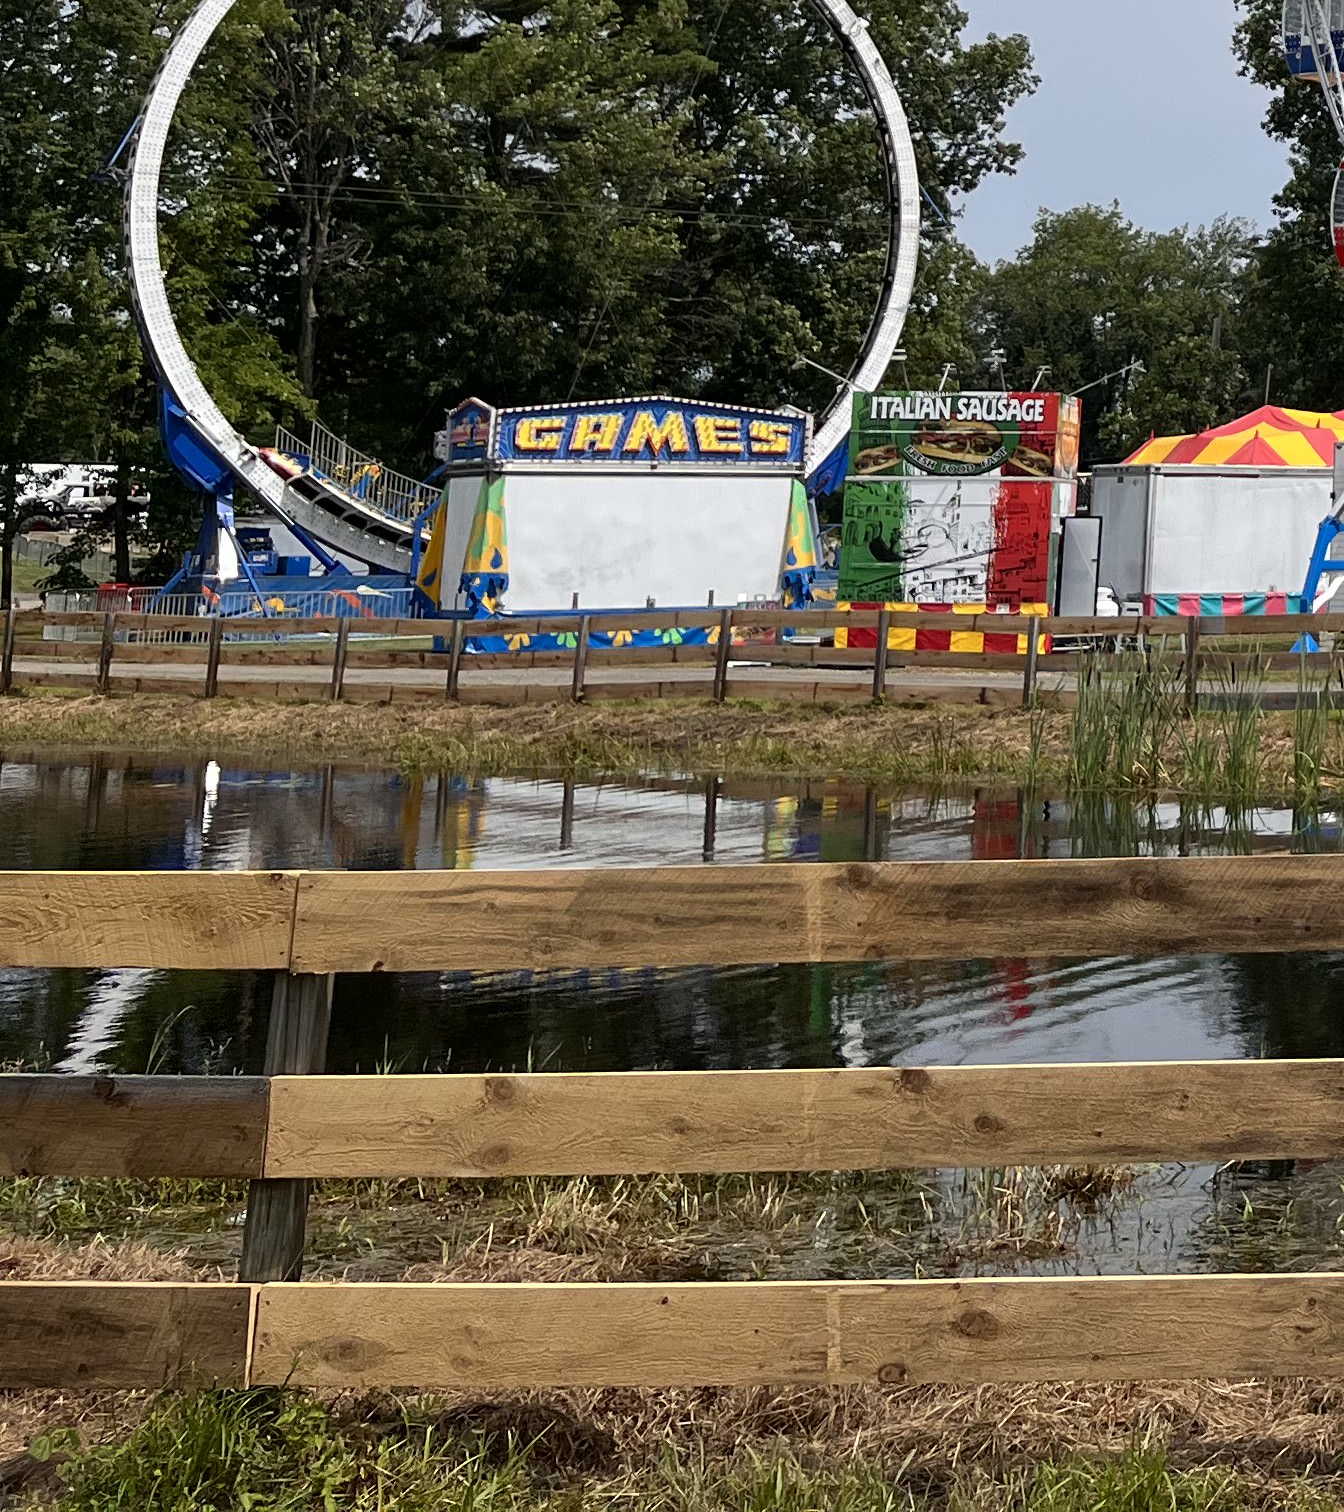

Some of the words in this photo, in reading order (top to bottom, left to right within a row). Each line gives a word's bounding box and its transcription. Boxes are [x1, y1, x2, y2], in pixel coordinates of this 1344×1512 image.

[869, 395, 952, 420] ITALIAN
[956, 397, 1045, 422] SAUSAGE
[514, 410, 793, 456] GAMES
[903, 444, 938, 470] FRESH
[941, 463, 976, 475] FOOD
[980, 446, 1008, 469] FAST
